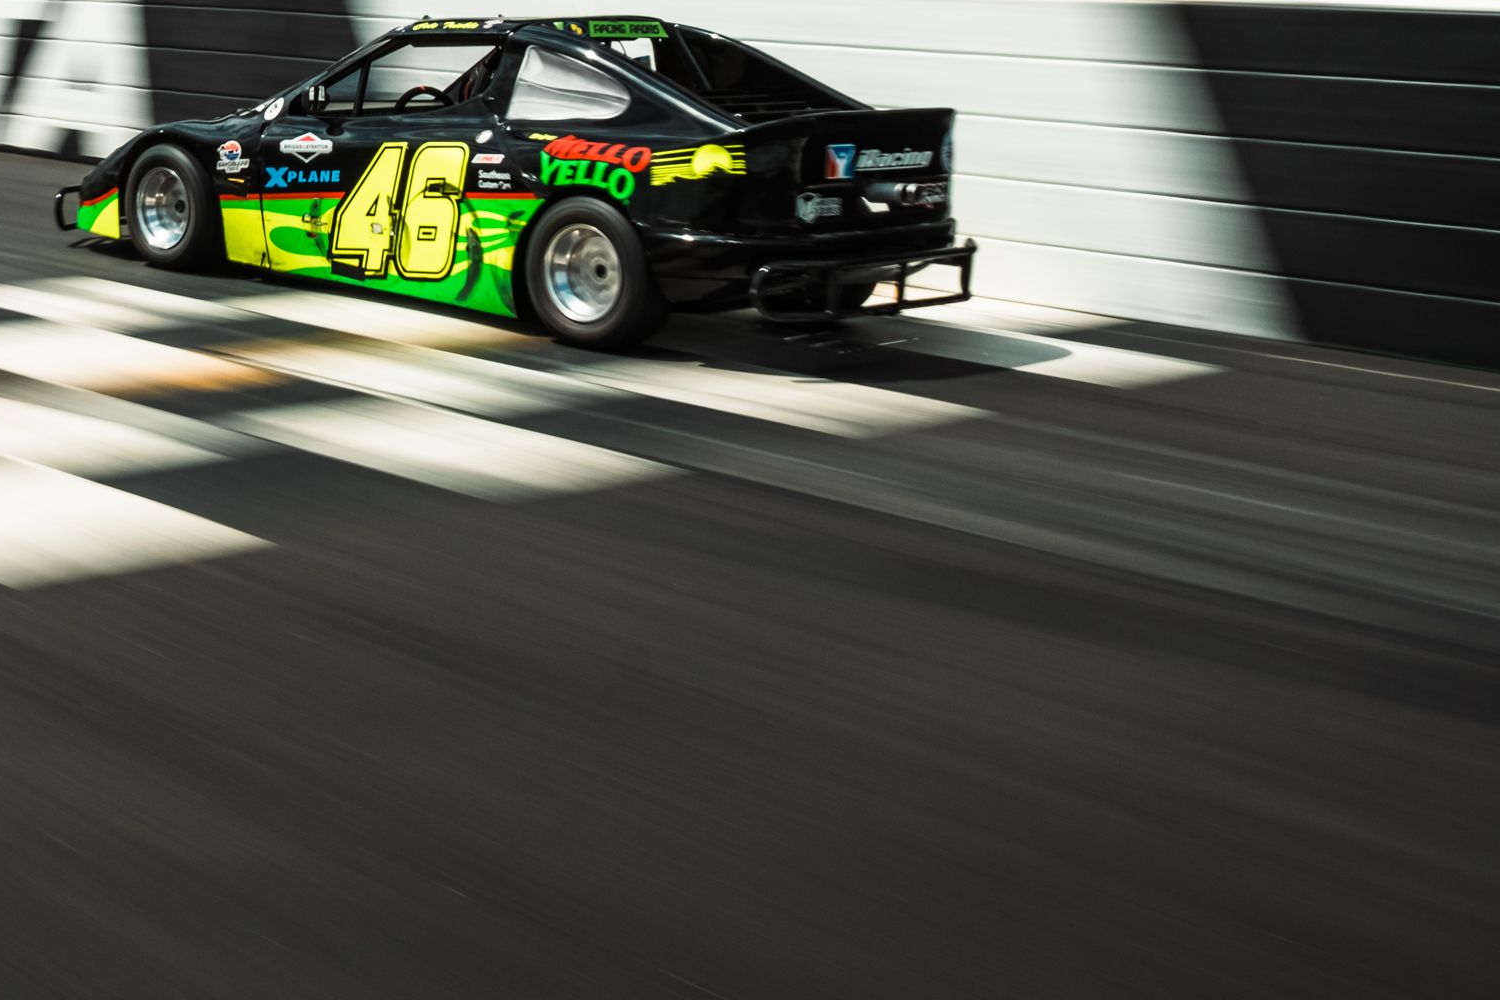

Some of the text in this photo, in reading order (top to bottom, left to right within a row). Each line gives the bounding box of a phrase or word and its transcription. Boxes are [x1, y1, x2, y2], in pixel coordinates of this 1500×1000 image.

[593, 24, 626, 34] RACING
[540, 150, 635, 200] YELLO
[542, 134, 652, 173] MELLO
[331, 141, 470, 279] 46
